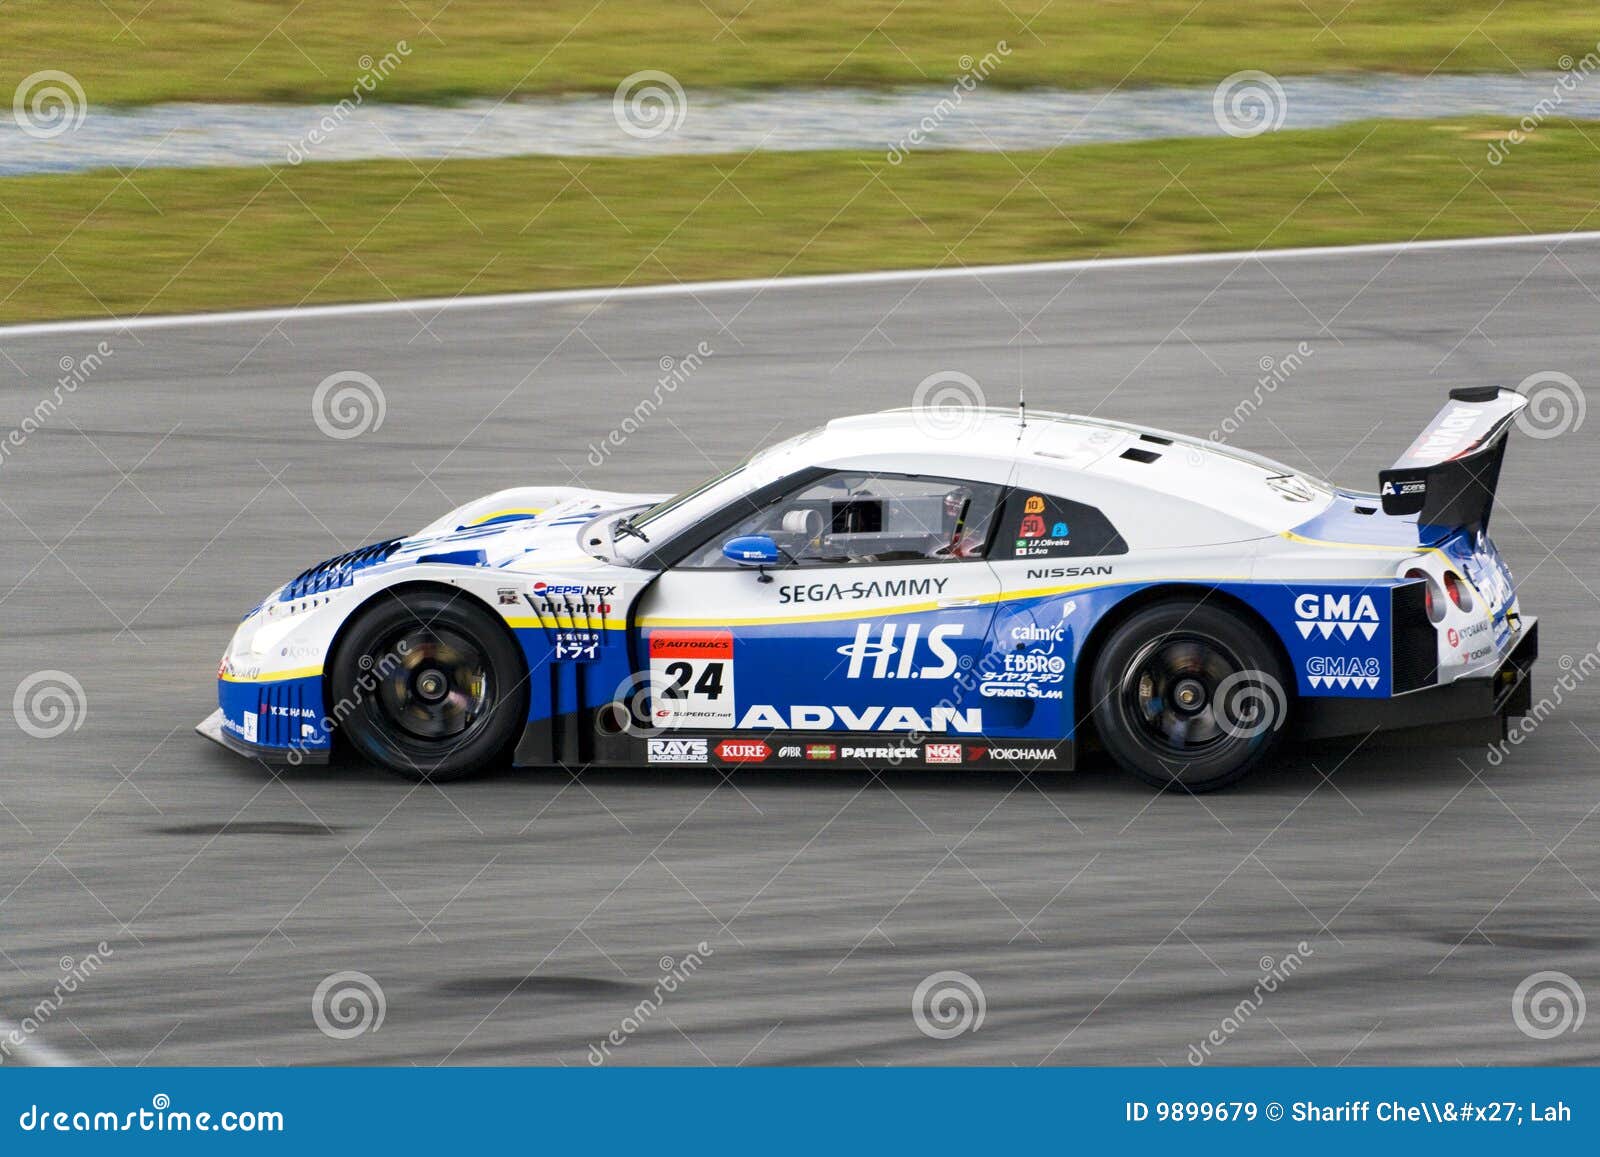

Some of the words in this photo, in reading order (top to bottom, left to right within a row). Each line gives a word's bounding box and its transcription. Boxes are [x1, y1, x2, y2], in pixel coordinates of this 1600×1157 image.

[1026, 566, 1113, 580] NISSAN
[547, 585, 583, 594] PEPSI
[586, 586, 617, 596] NEX
[1294, 594, 1380, 621] GMA
[556, 642, 599, 659] トライ
[666, 641, 729, 649] AUTOBACS
[837, 623, 964, 679] H.I.S.
[1004, 655, 1066, 674] EBBRO
[1306, 656, 1380, 677] GMA8
[661, 661, 724, 700] 24
[736, 705, 982, 733] ADVAN
[648, 741, 707, 755] RAYS
[722, 745, 764, 757] KURE
[841, 747, 919, 758] PATRICK
[926, 744, 961, 758] NGK
[988, 749, 1057, 760] YOKOHAMA
